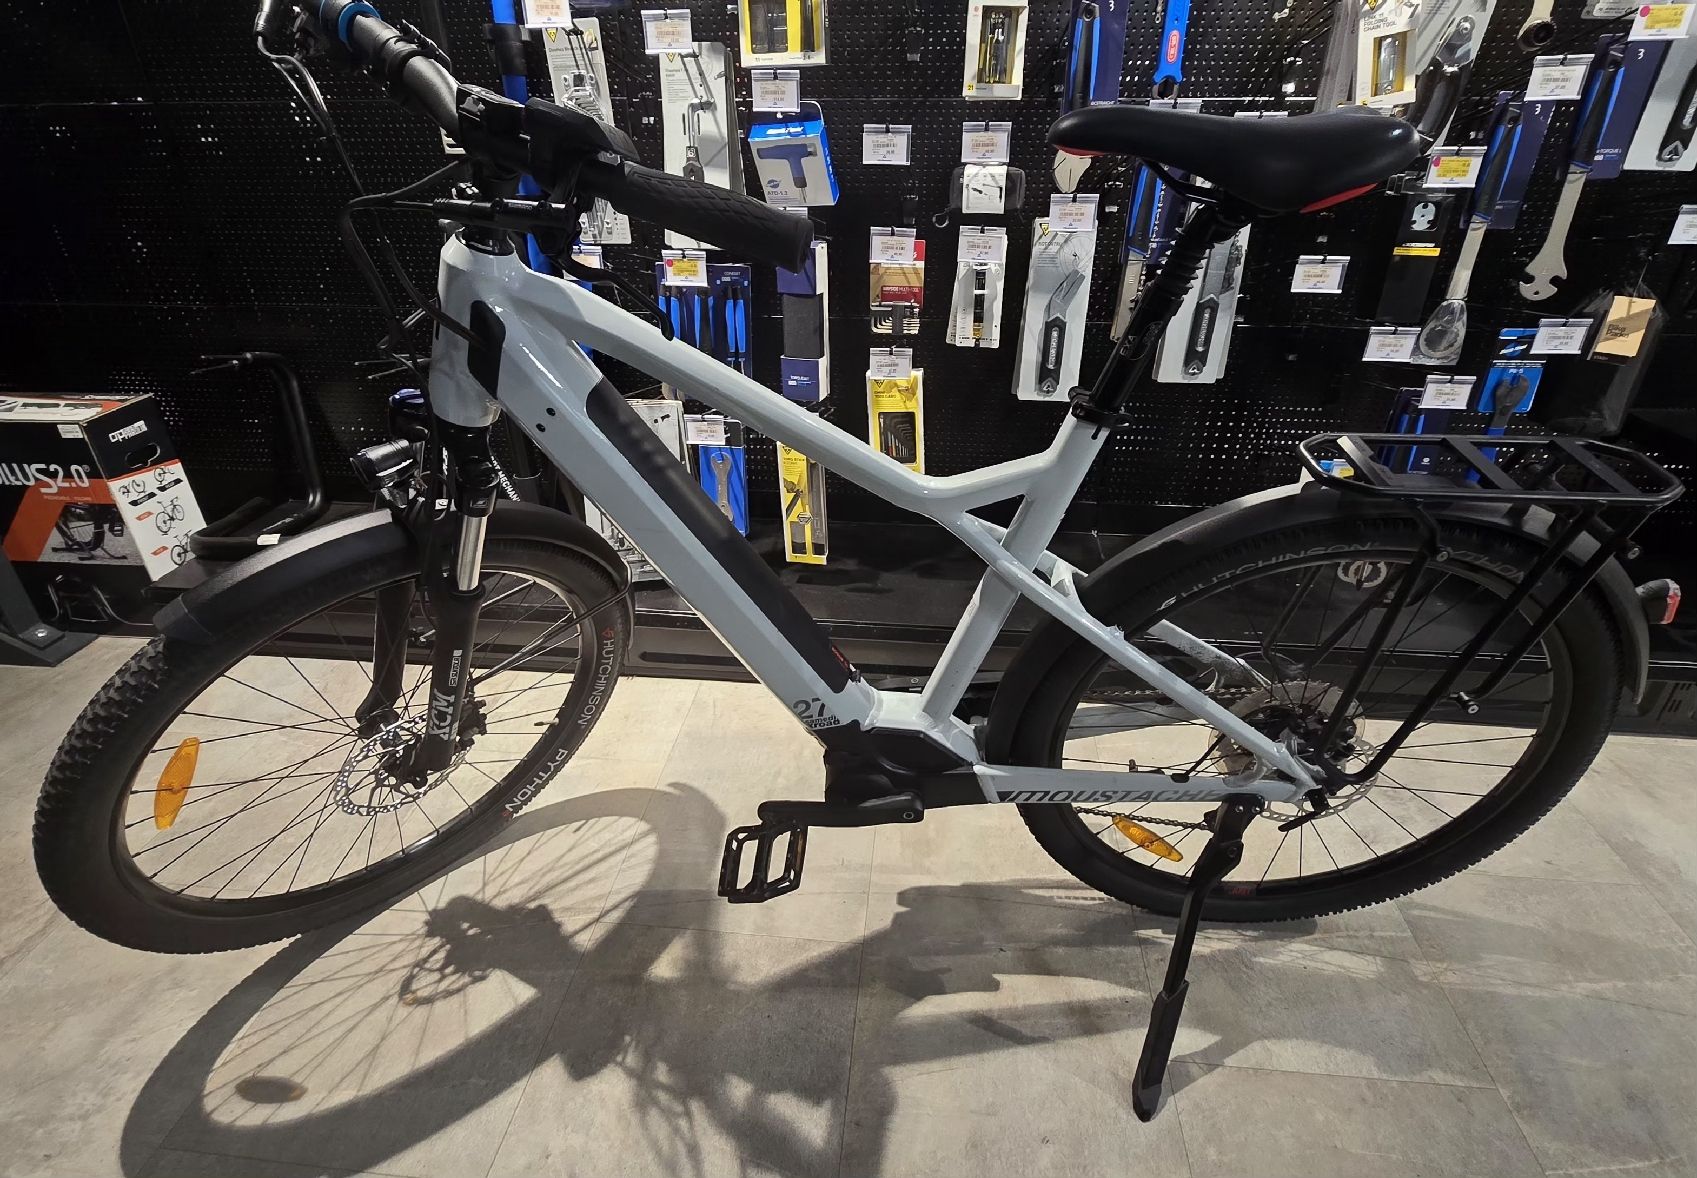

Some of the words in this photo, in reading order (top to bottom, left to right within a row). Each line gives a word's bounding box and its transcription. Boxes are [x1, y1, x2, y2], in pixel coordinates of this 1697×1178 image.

[577, 639, 615, 726] HUTCHINSON
[792, 697, 826, 719] 27
[504, 748, 569, 812] PYTHON
